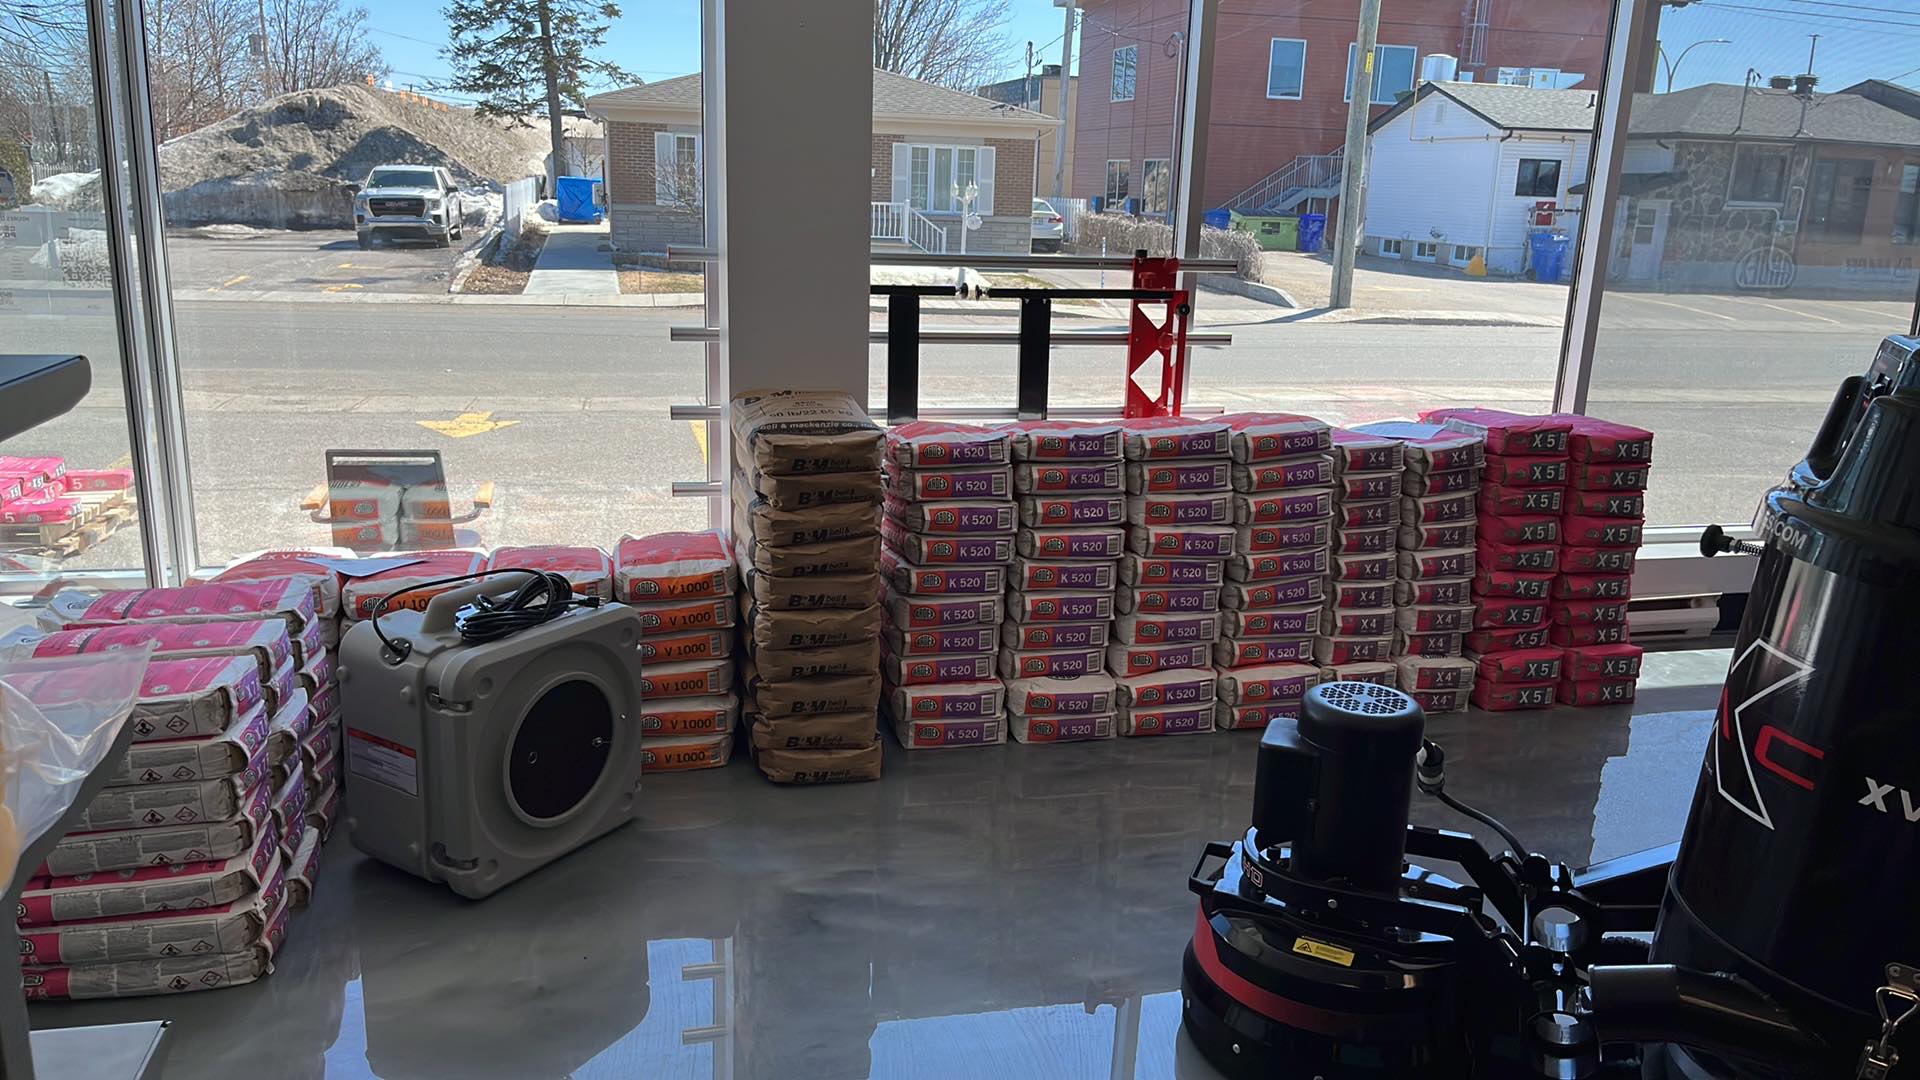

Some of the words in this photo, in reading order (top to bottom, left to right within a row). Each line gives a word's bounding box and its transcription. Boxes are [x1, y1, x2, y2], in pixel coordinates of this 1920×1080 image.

[1069, 441, 1077, 450] K
[1079, 440, 1099, 450] 520
[1182, 440, 1190, 450] K
[1191, 440, 1211, 449] 520
[1284, 439, 1292, 448] K
[1294, 437, 1313, 447] 520
[953, 448, 961, 458] K
[964, 447, 984, 457] 520
[1070, 474, 1078, 484] K
[1081, 474, 1100, 483] 520
[1180, 474, 1187, 483] K
[1190, 473, 1209, 482] 520
[1287, 472, 1294, 481] K
[1296, 470, 1314, 479] 520
[956, 482, 963, 491] K
[966, 480, 987, 491] 520
[1074, 508, 1082, 517] K
[1084, 507, 1103, 517] 520
[1178, 508, 1185, 517] K
[1188, 507, 1207, 517] 520
[1285, 505, 1292, 514] K
[1295, 503, 1313, 512] 520
[962, 516, 969, 525] K
[972, 515, 992, 525] 520
[1072, 542, 1080, 551] K
[1082, 541, 1102, 551] 520
[1185, 541, 1192, 550] K
[1195, 540, 1214, 550] 520
[960, 547, 967, 556] K
[970, 546, 990, 556] 520
[1283, 561, 1291, 571] K
[1293, 560, 1310, 569] 520
[1173, 568, 1180, 577] K
[1182, 568, 1201, 577] 520
[950, 578, 957, 588] K
[960, 578, 980, 587] 520
[1061, 574, 1068, 583] K
[1071, 573, 1091, 582] 520
[668, 585, 676, 594] V
[680, 581, 709, 594] 1000
[1278, 591, 1285, 600] K
[1287, 588, 1305, 598] 520
[1170, 598, 1177, 607] K
[1179, 597, 1199, 606] 520
[1062, 605, 1070, 614] K
[1072, 604, 1092, 613] 520
[670, 617, 677, 626] V
[683, 612, 711, 625] 1000
[1274, 620, 1281, 629] K
[1283, 619, 1302, 628] 520
[1168, 628, 1175, 637] K
[1177, 627, 1196, 636] 520
[665, 648, 672, 656] V
[677, 643, 706, 655] 1000
[1268, 649, 1276, 659] K
[1278, 648, 1295, 658] 520
[1160, 657, 1167, 666] K
[1169, 655, 1188, 664] 520
[940, 667, 948, 676] K
[951, 666, 971, 675] 520
[1052, 662, 1060, 671] K
[1063, 661, 1082, 670] 520
[662, 683, 669, 692] V
[673, 680, 704, 691] 1000
[945, 703, 953, 712] K
[955, 702, 976, 711] 520
[671, 721, 677, 730] V
[682, 719, 711, 729] 1000
[665, 754, 672, 763] V
[676, 751, 705, 763] 1000
